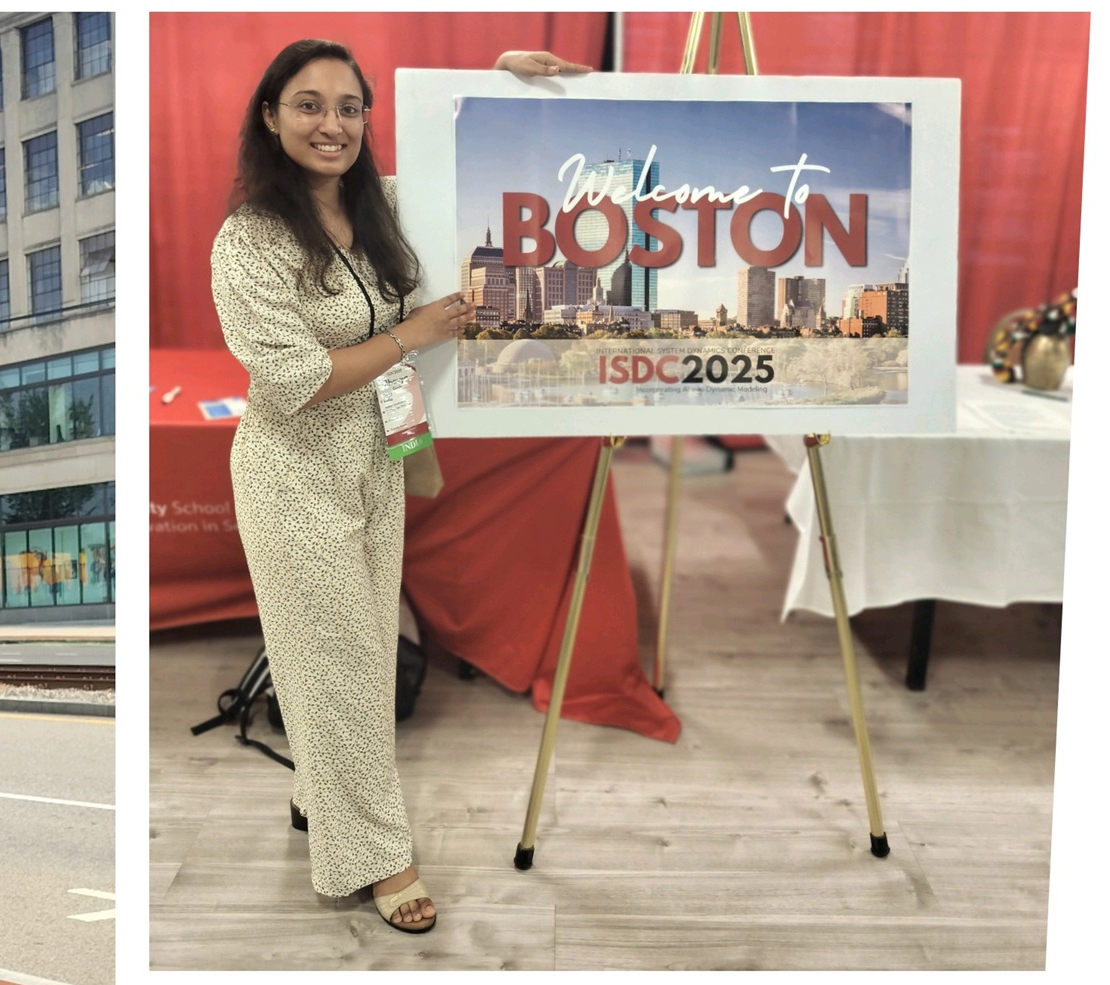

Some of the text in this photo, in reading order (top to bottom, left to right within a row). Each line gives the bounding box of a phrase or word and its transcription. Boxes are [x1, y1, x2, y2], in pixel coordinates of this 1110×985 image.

[557, 144, 831, 219] Welcome to
[502, 191, 869, 268] BOSTON
[596, 347, 655, 355] INTERNATIONAL
[657, 347, 686, 355] SYSTEM
[727, 346, 776, 354] CONFERENCE
[598, 354, 775, 385] ISDC2025
[171, 500, 232, 516] School
[201, 520, 220, 532] in
